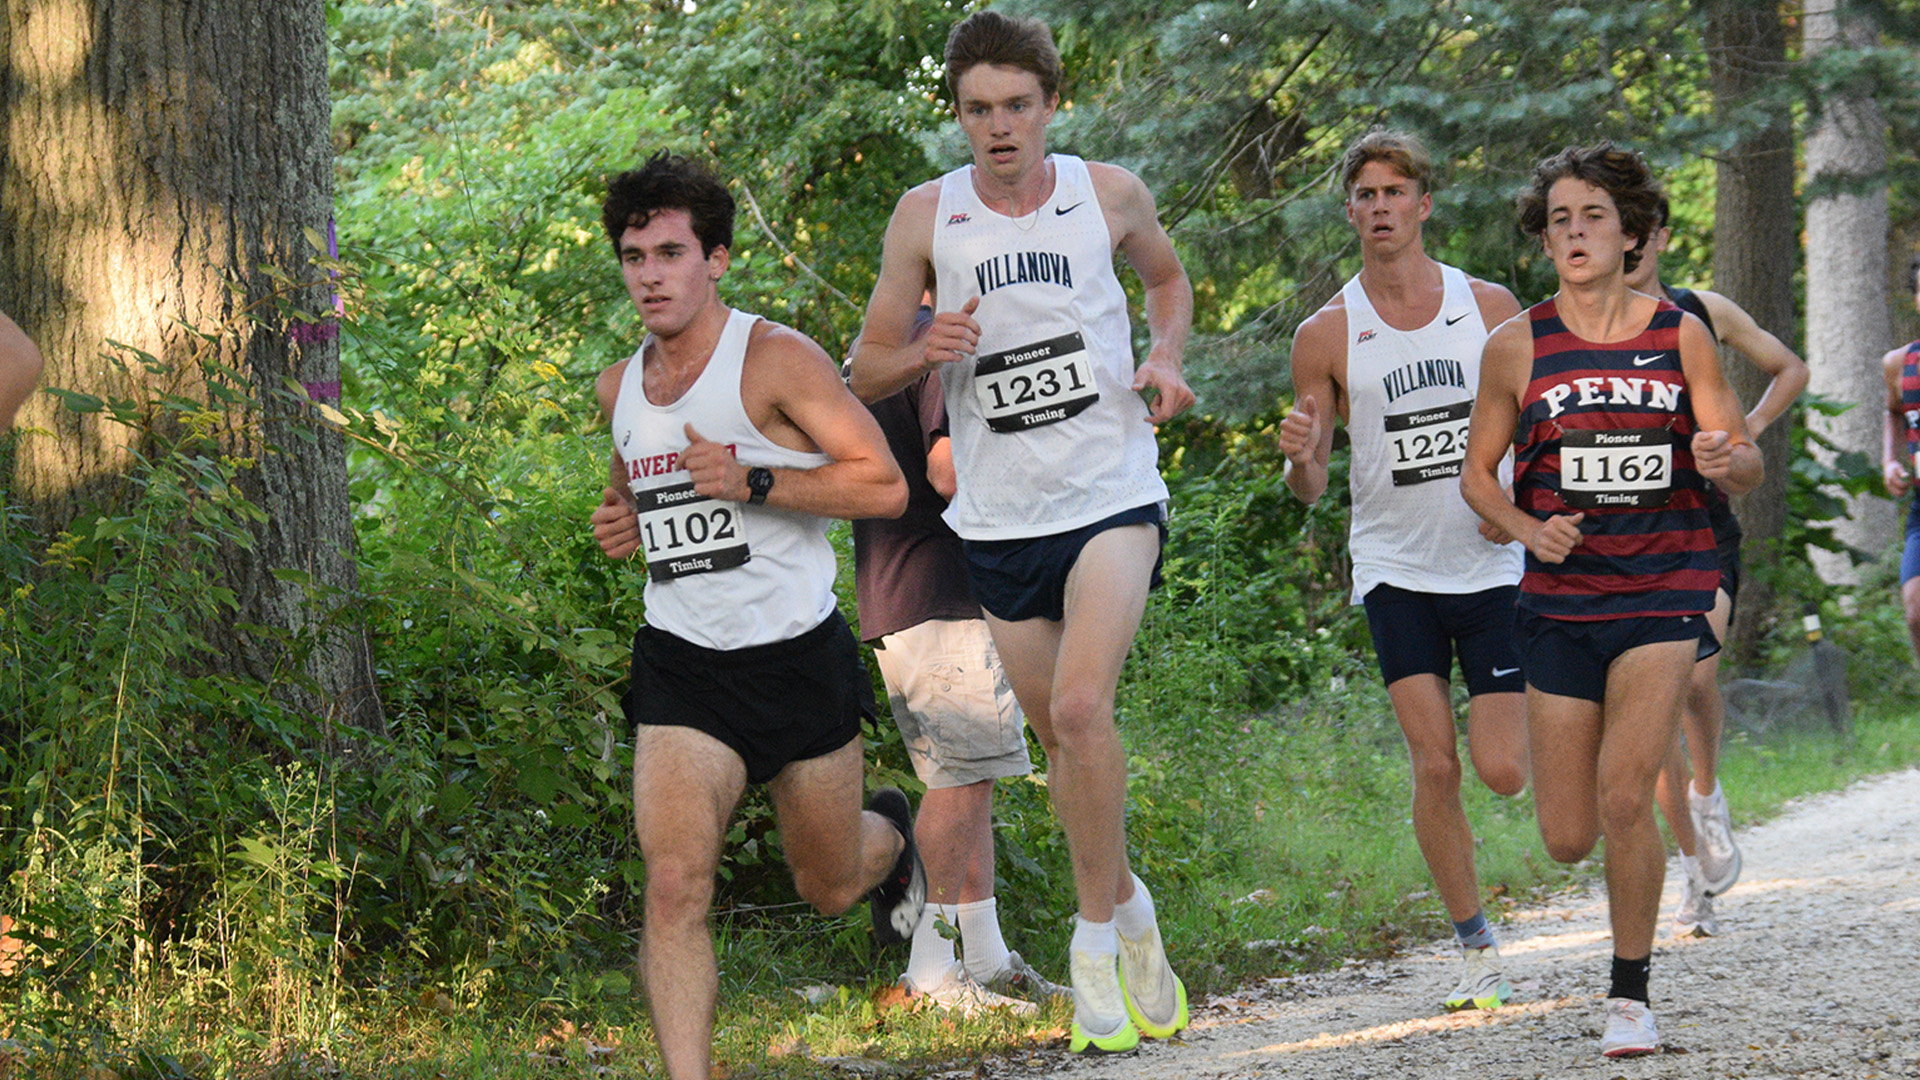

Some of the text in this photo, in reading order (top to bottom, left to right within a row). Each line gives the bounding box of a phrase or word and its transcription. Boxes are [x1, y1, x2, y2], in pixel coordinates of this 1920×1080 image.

[975, 251, 1073, 297] VILLANOVA
[1003, 346, 1051, 366] Pioneer
[987, 362, 1086, 410] 1231
[1383, 359, 1466, 404] VILLANOVA
[1540, 377, 1683, 419] PENN
[1021, 407, 1066, 426] Timing
[1408, 410, 1450, 426] Pioneer
[1594, 434, 1641, 444] Pioneer
[1419, 465, 1460, 478] Timing
[1571, 454, 1665, 483] 1162
[656, 489, 699, 504] Pionee
[1595, 494, 1639, 505] Timing
[644, 507, 735, 553] 1102
[669, 557, 713, 573] Timing
